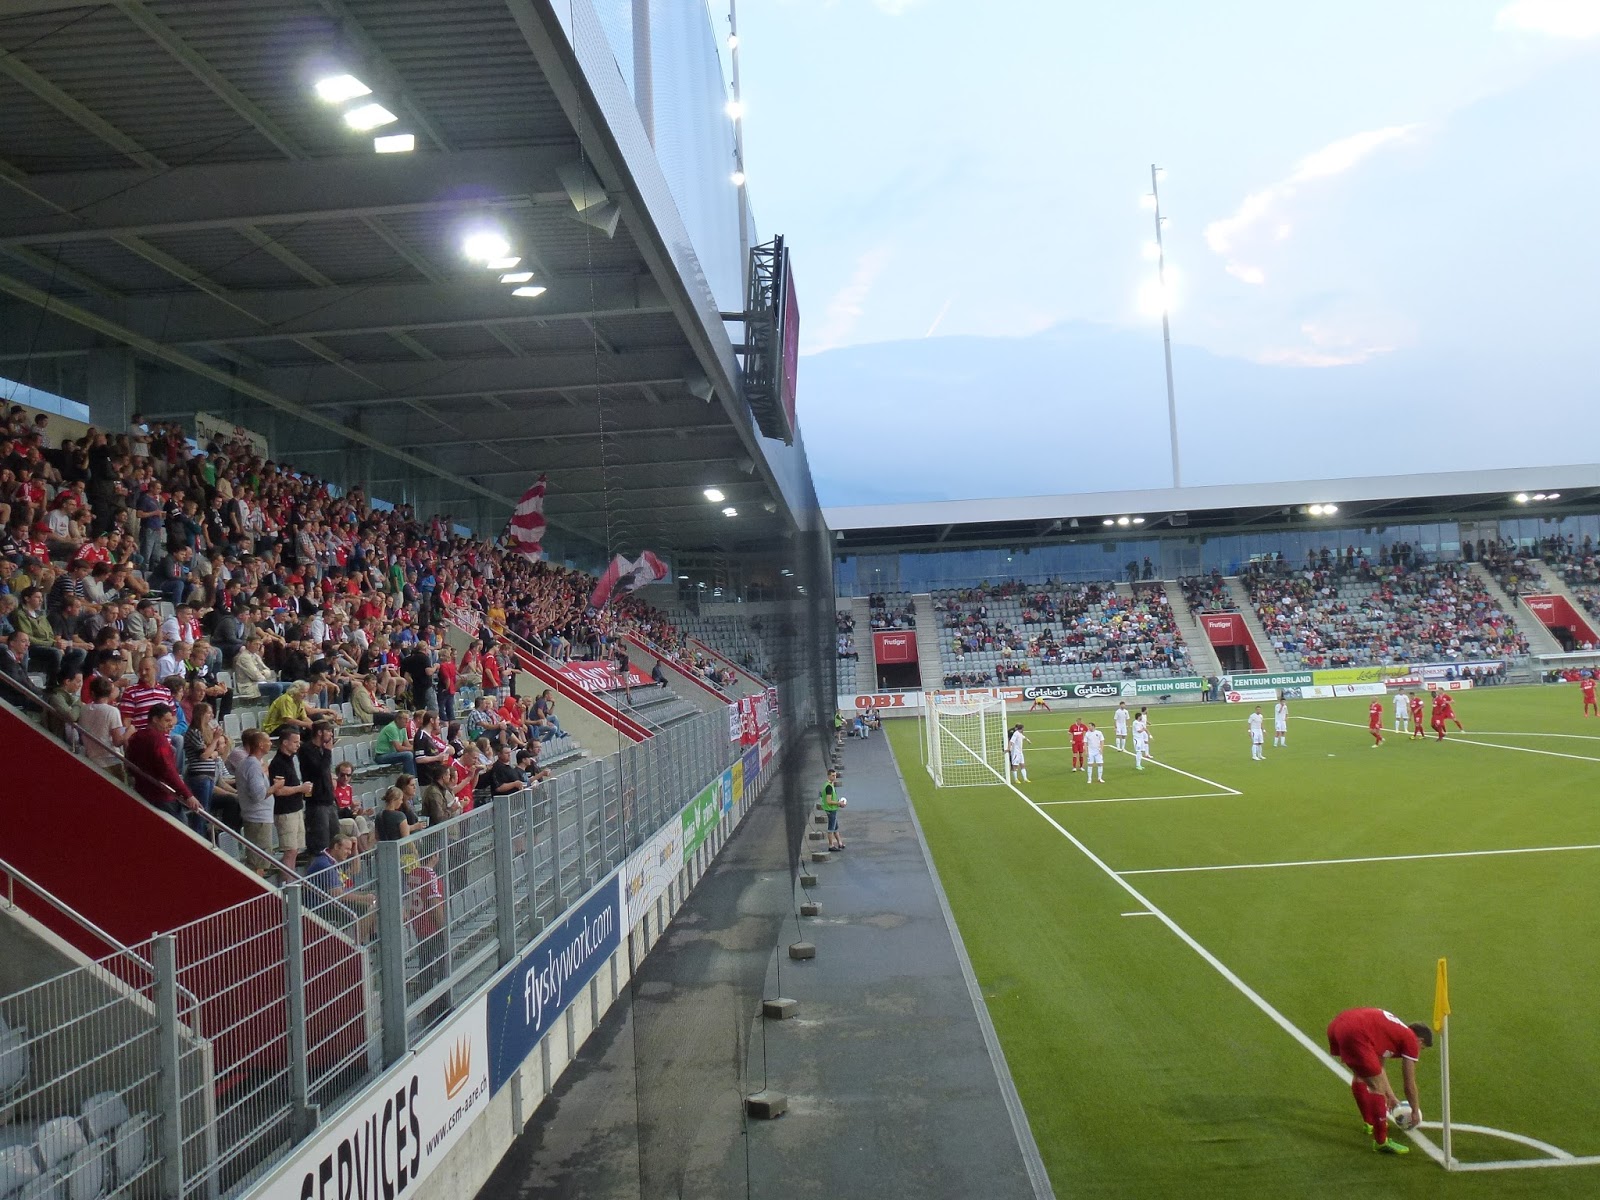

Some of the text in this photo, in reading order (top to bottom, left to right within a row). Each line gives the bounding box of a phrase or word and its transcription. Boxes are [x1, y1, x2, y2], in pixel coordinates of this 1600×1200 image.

[1137, 683, 1173, 691] ZENTRUM
[1234, 678, 1270, 687] ZENTRUM
[1271, 675, 1311, 684] OBERLAND
[1024, 687, 1068, 699] Carlsberg
[1074, 684, 1118, 697] Carlsberg
[855, 695, 905, 708] OBI
[524, 904, 613, 1032] flyskywork.com
